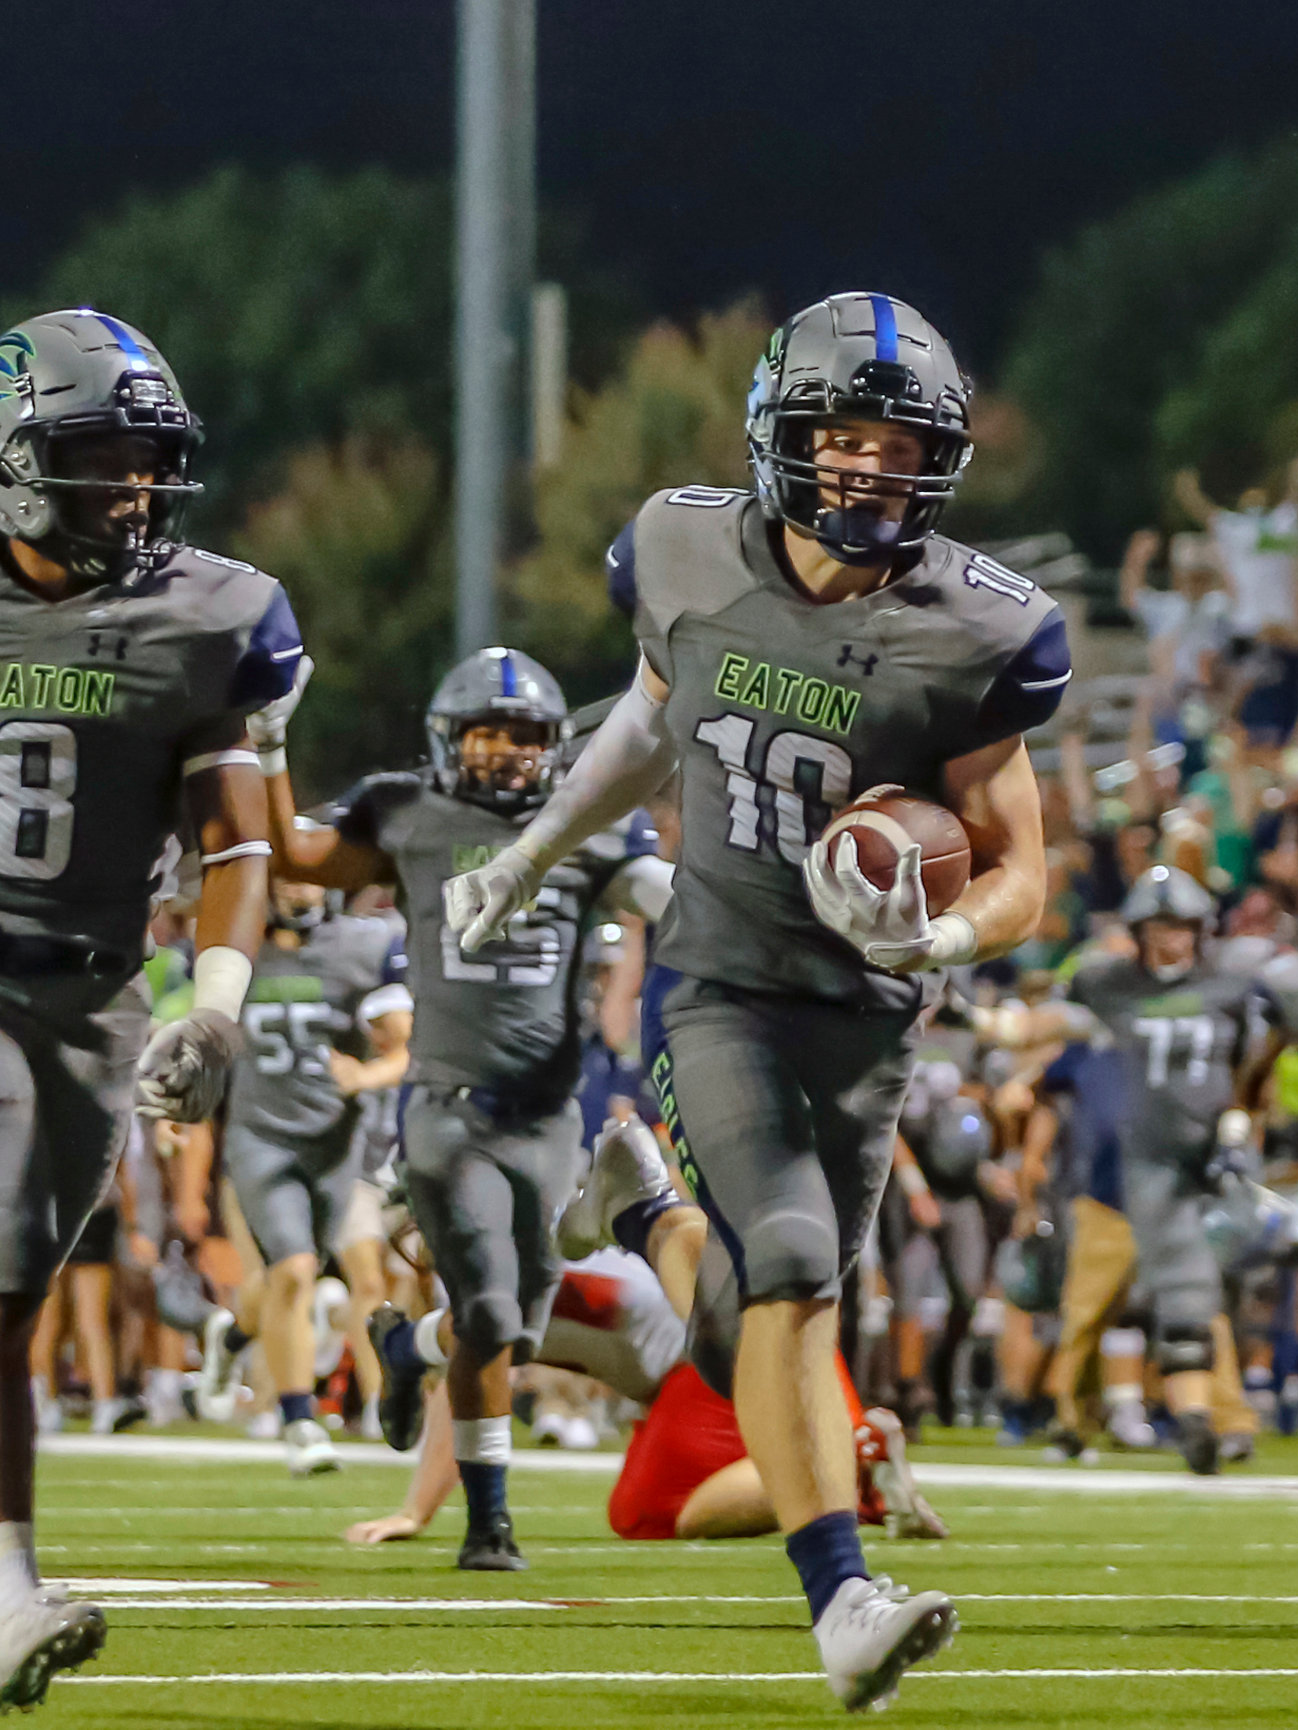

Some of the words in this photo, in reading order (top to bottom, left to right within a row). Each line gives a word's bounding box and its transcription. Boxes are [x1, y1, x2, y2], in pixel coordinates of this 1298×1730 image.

[714, 652, 862, 735] EATON
[0, 721, 77, 880] 8
[694, 712, 853, 868] 10
